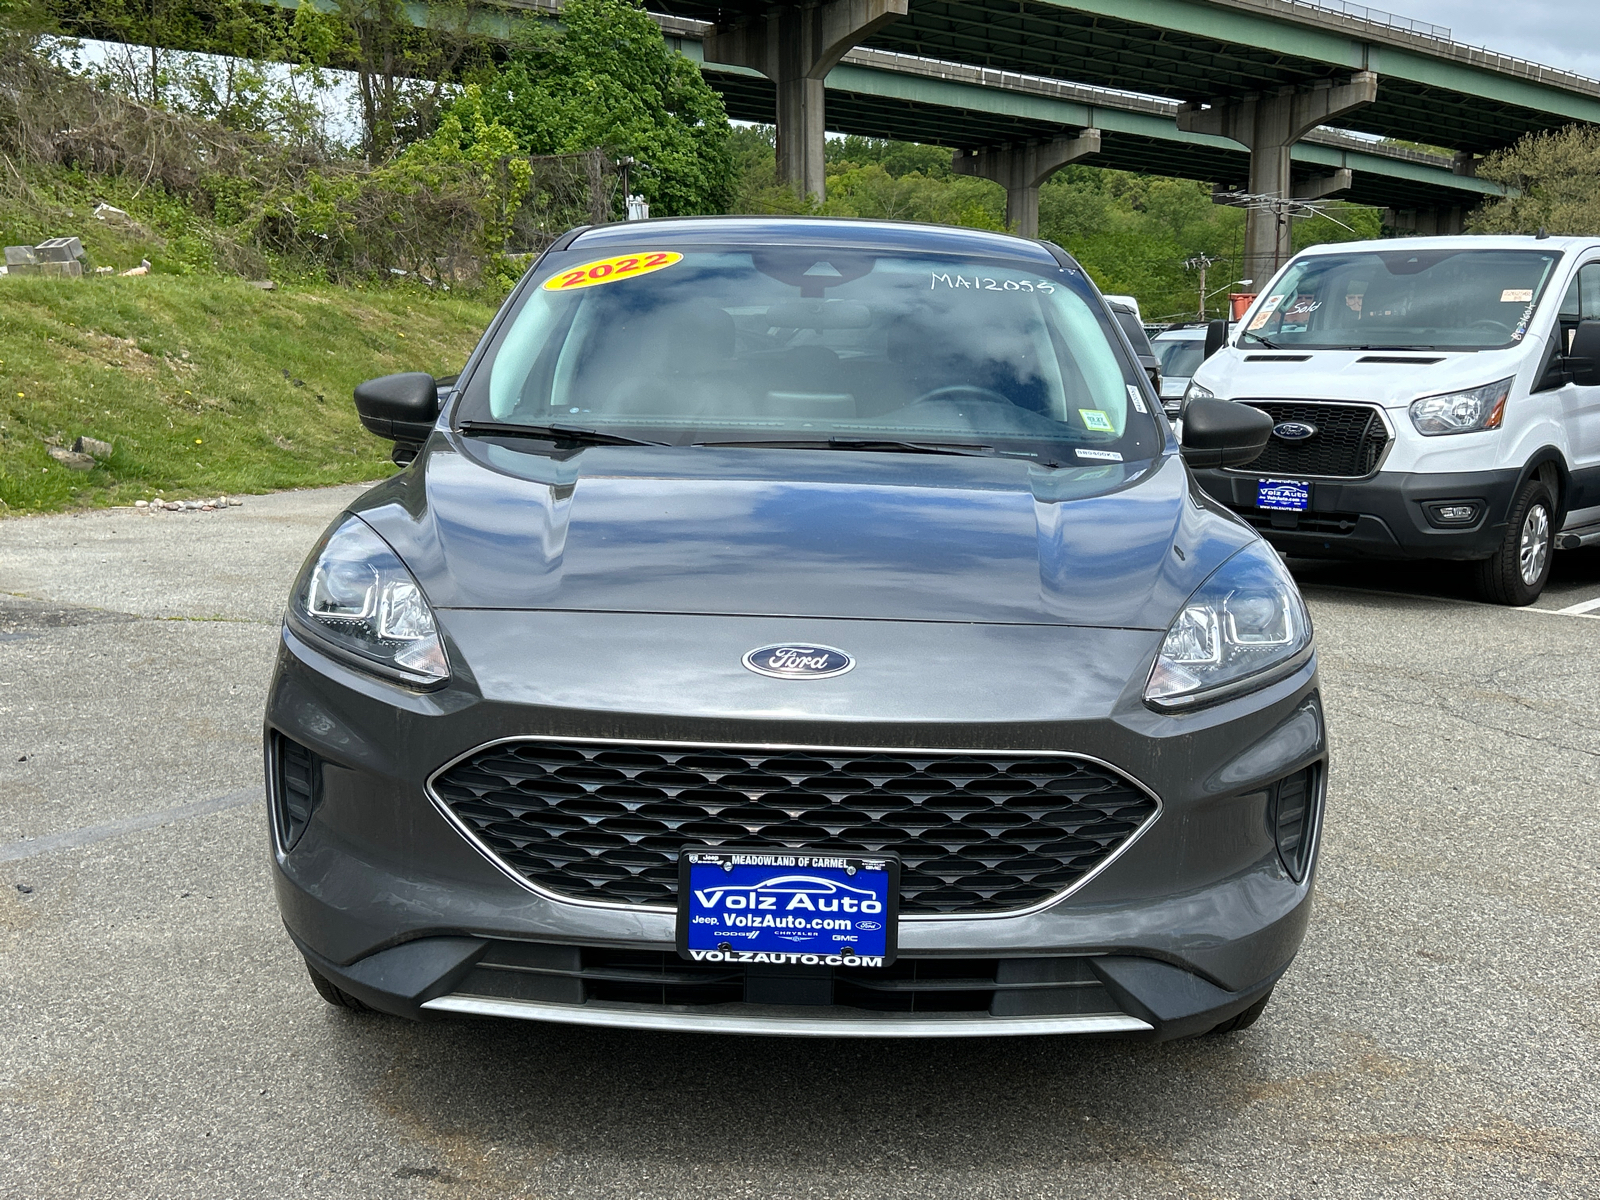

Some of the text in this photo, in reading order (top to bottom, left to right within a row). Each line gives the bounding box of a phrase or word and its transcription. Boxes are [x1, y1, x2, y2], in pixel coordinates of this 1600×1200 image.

[561, 253, 669, 288] 2022
[1285, 301, 1323, 316] Sold
[1280, 424, 1304, 436] Ford
[1260, 488, 1308, 498] Volz Auto
[768, 647, 829, 669] Ford
[731, 855, 796, 867] MEADOWLAND
[797, 857, 810, 867] OF
[812, 858, 848, 869] CARMEL
[694, 890, 882, 914] Volz Auto
[723, 913, 851, 930] VolzAuto.com
[832, 934, 858, 942] GMC
[689, 950, 882, 967] VOLZAUTO.COM
